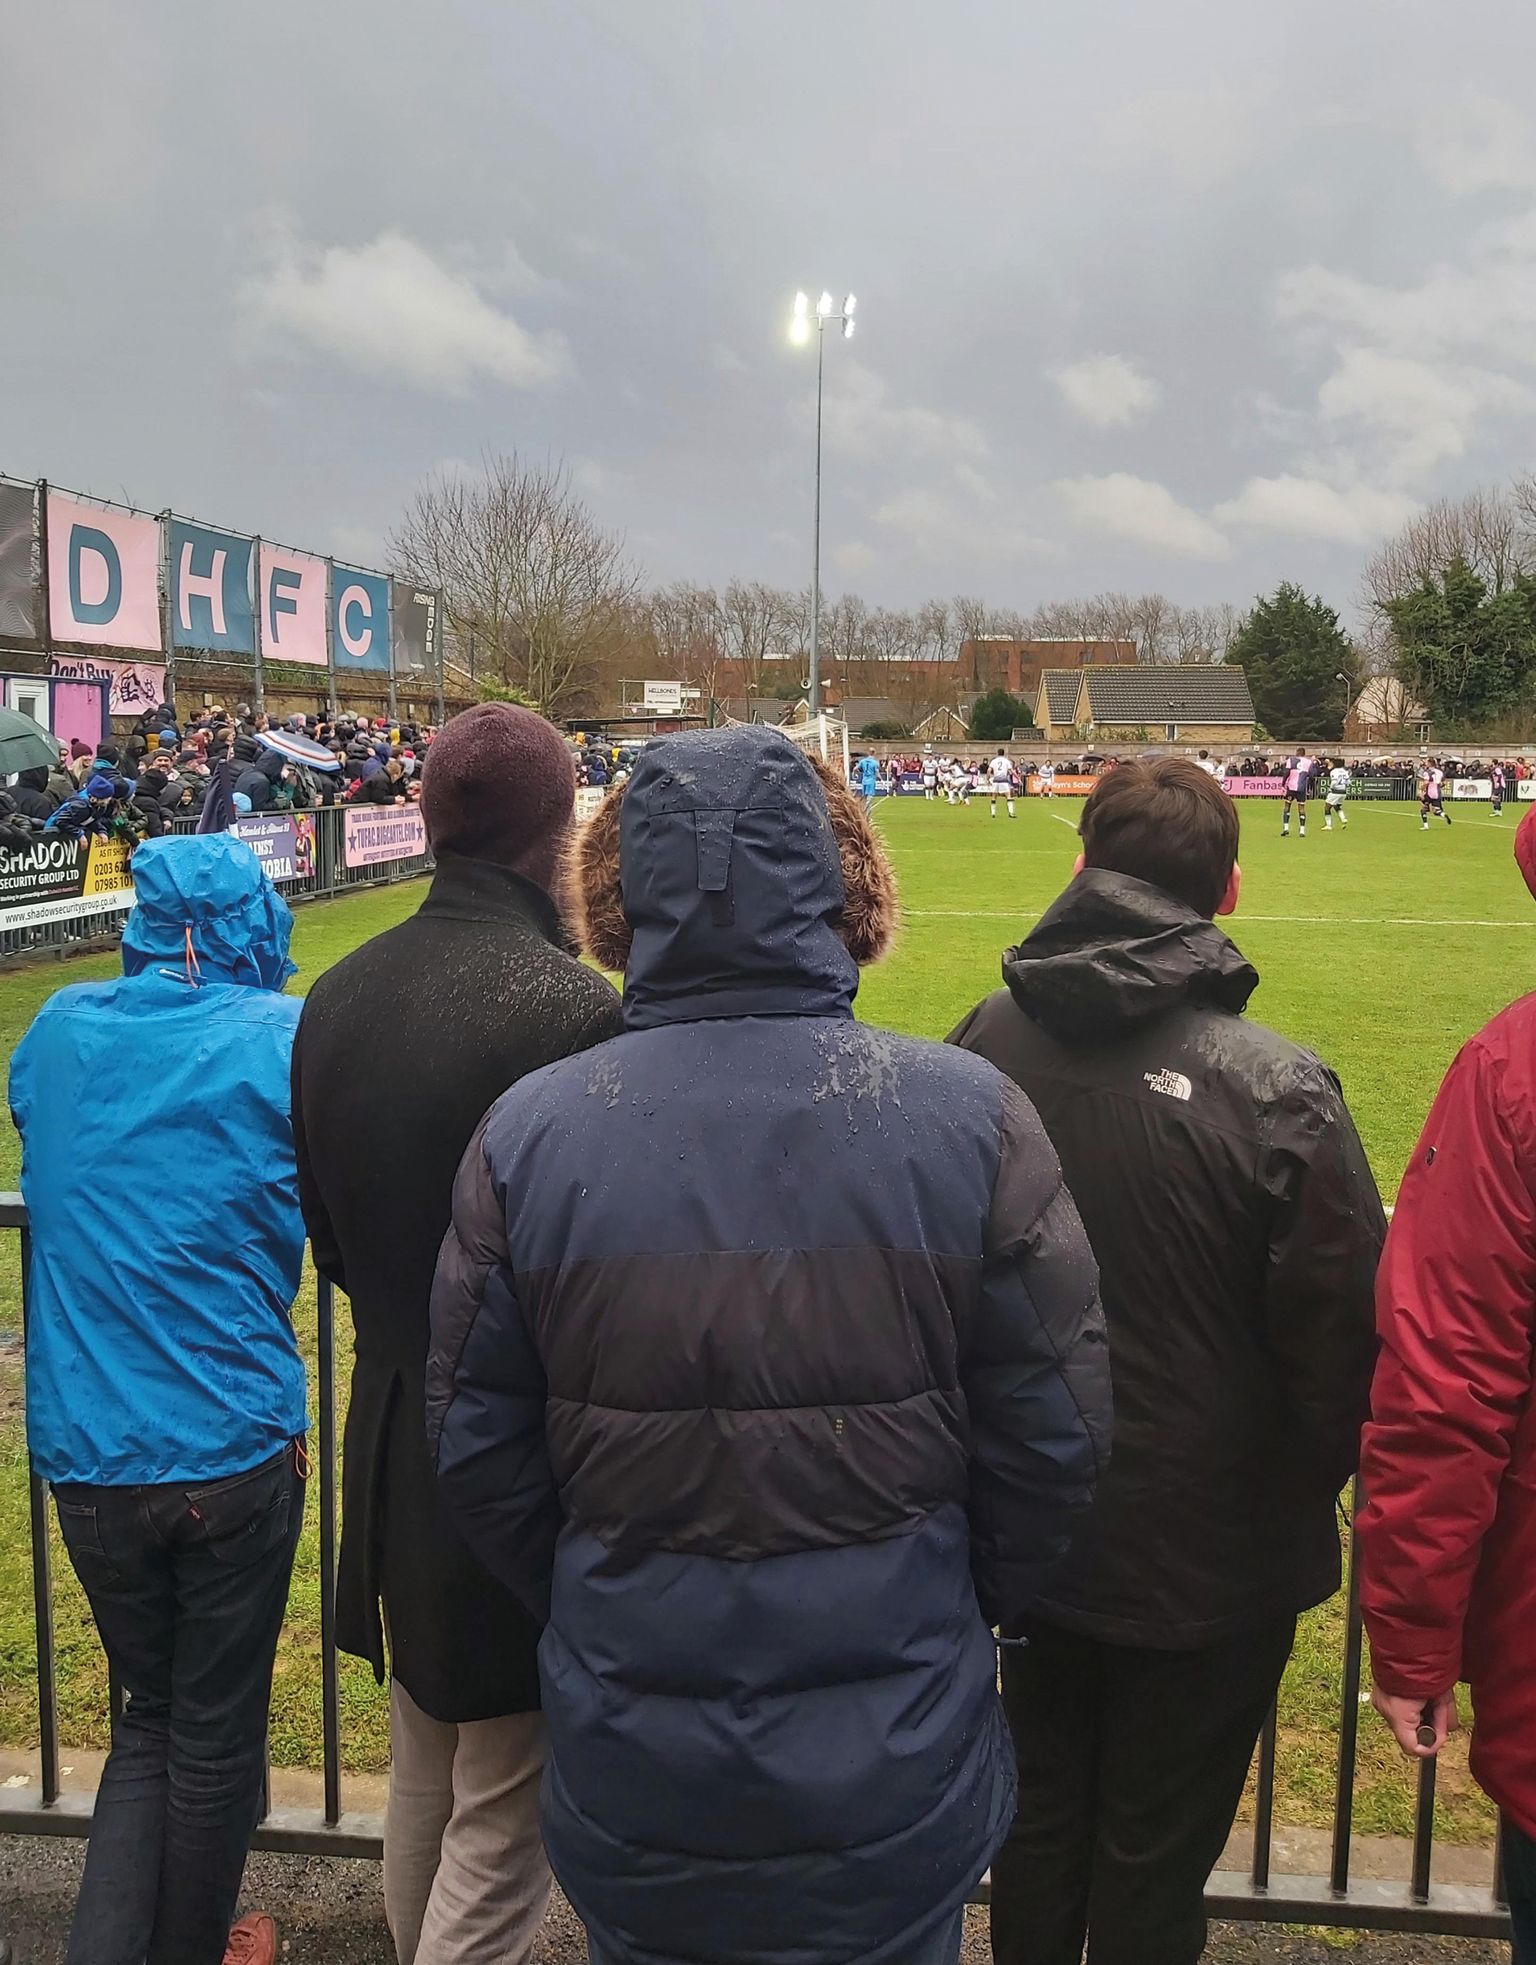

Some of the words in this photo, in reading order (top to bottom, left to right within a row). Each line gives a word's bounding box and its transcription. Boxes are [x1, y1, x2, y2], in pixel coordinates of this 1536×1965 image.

[997, 761, 1003, 771] 2
[1243, 779, 1284, 790] Fanbas
[0, 839, 78, 874] SHADOW
[94, 862, 113, 876] 0203
[114, 861, 124, 873] 62
[0, 874, 37, 889] SECURITY
[38, 871, 65, 884] GROUP
[66, 869, 79, 880] LTD
[95, 877, 118, 891] 07985
[120, 875, 133, 887] 101
[5, 895, 118, 924] www.shadowsecuritygroup.co.uk
[1143, 1072, 1176, 1088] NORTH
[1160, 1067, 1180, 1081] THE
[1149, 1082, 1175, 1096] FACE
